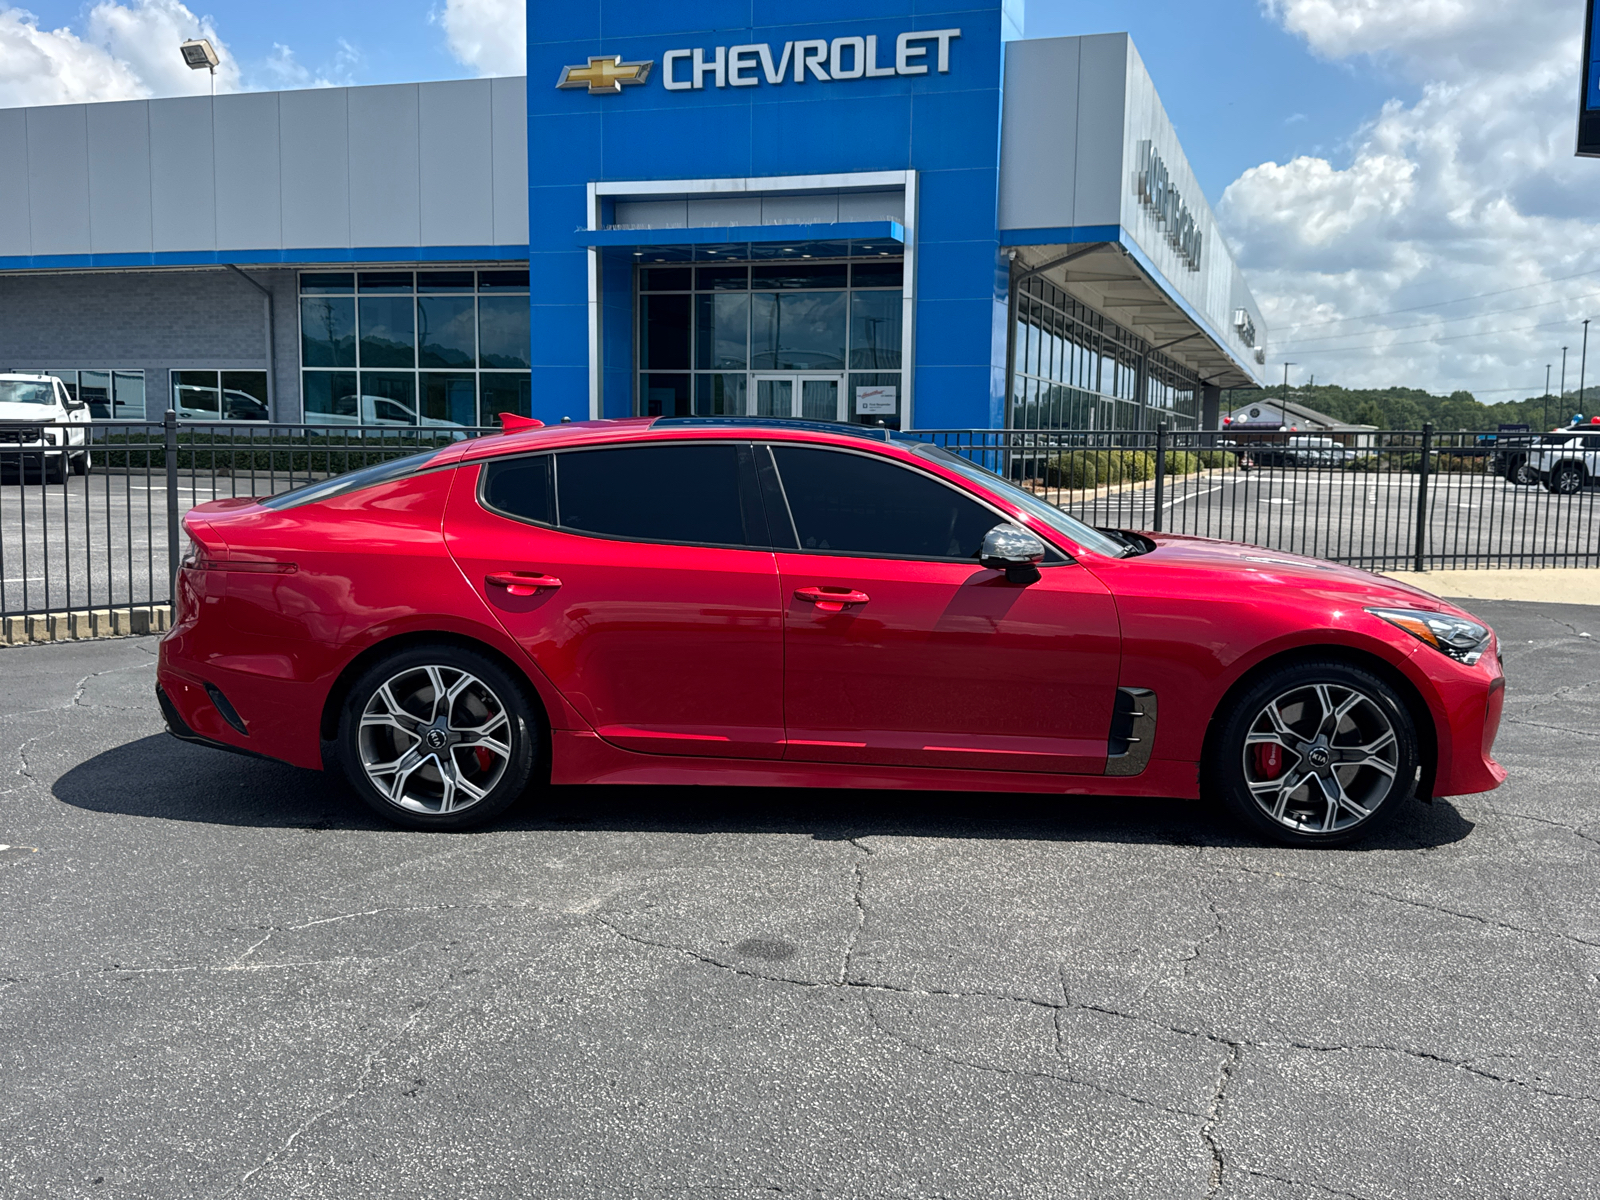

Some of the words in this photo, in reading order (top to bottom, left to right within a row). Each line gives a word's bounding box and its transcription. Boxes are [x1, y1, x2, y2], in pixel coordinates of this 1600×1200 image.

[662, 28, 962, 91] CHEVROLET
[430, 732, 441, 747] KIA
[1311, 752, 1327, 763] KIA
